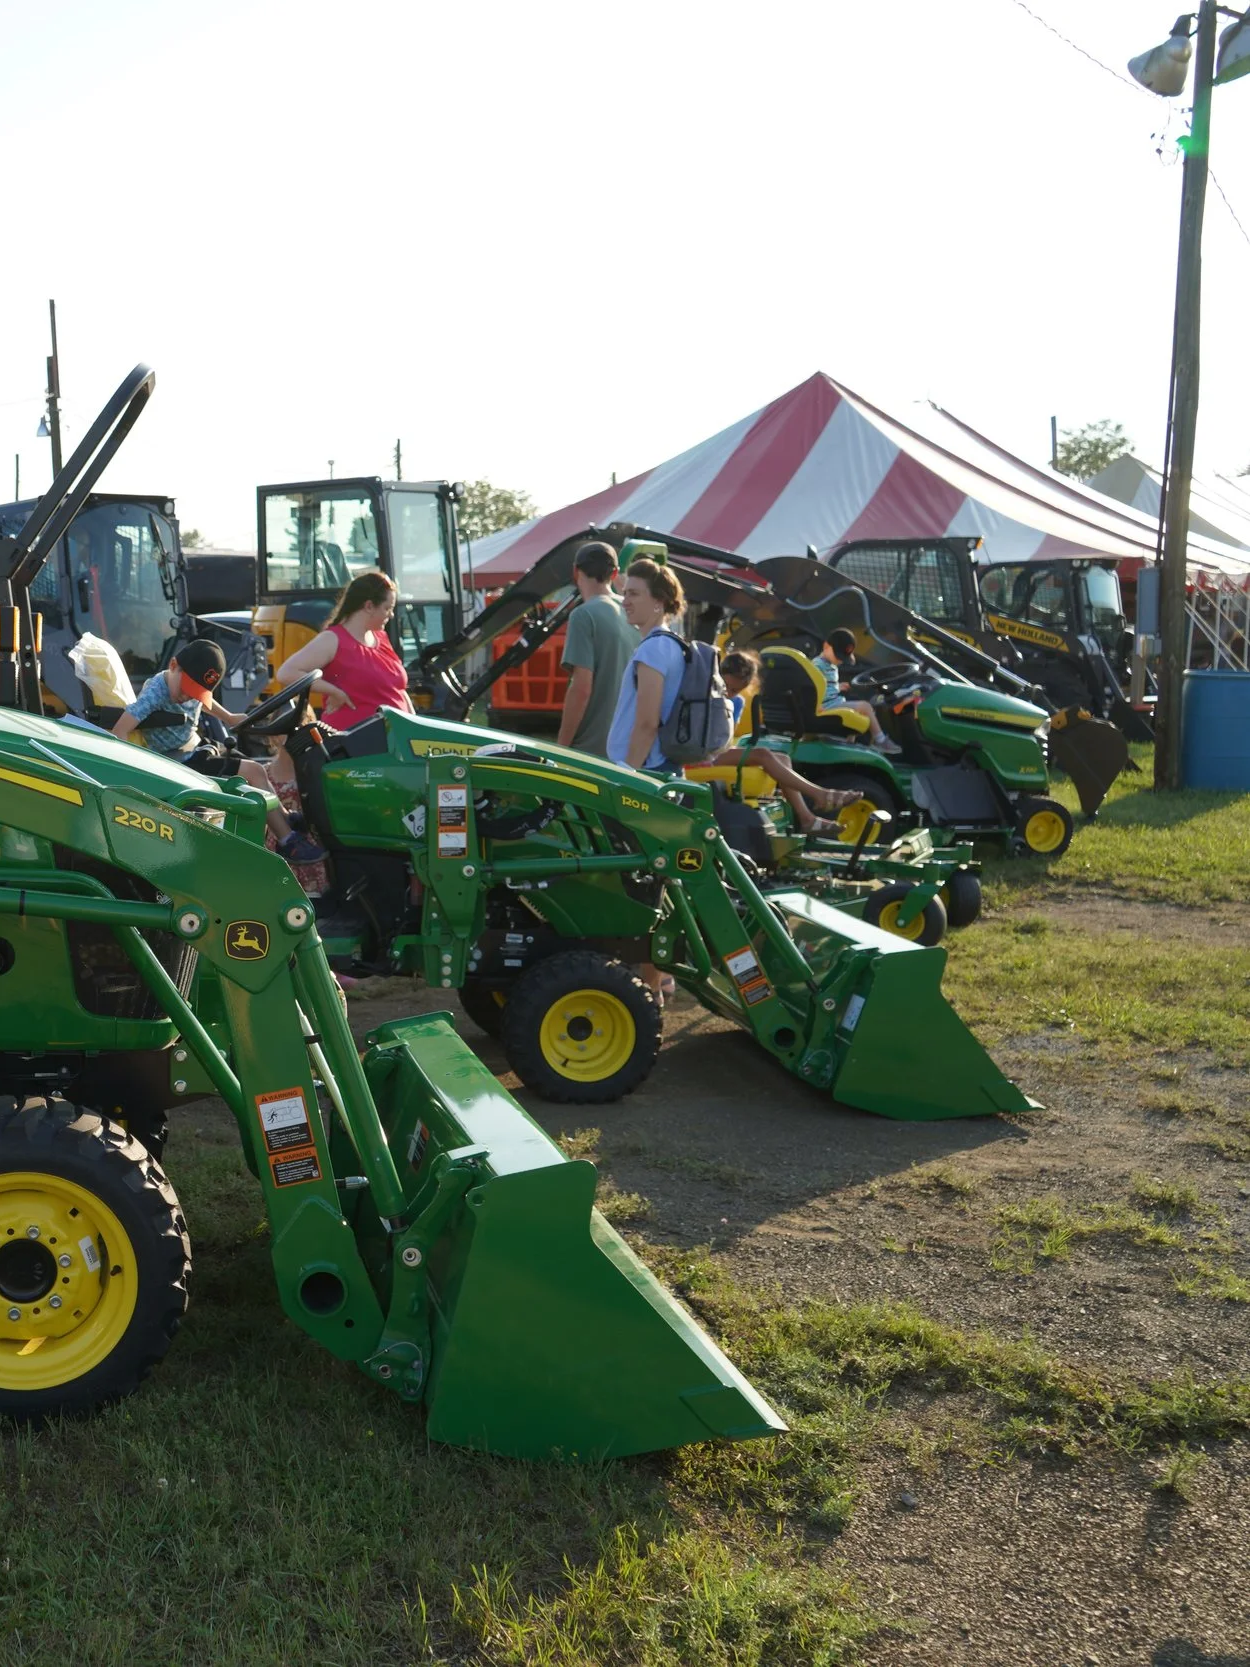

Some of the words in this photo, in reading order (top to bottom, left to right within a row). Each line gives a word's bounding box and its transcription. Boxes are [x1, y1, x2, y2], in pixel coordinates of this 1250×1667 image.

[621, 795, 641, 809] 120
[641, 803, 650, 813] R
[114, 804, 157, 834] 220
[159, 822, 175, 842] R
[268, 1090, 299, 1101] WARNING
[282, 1150, 313, 1161] WARNING
